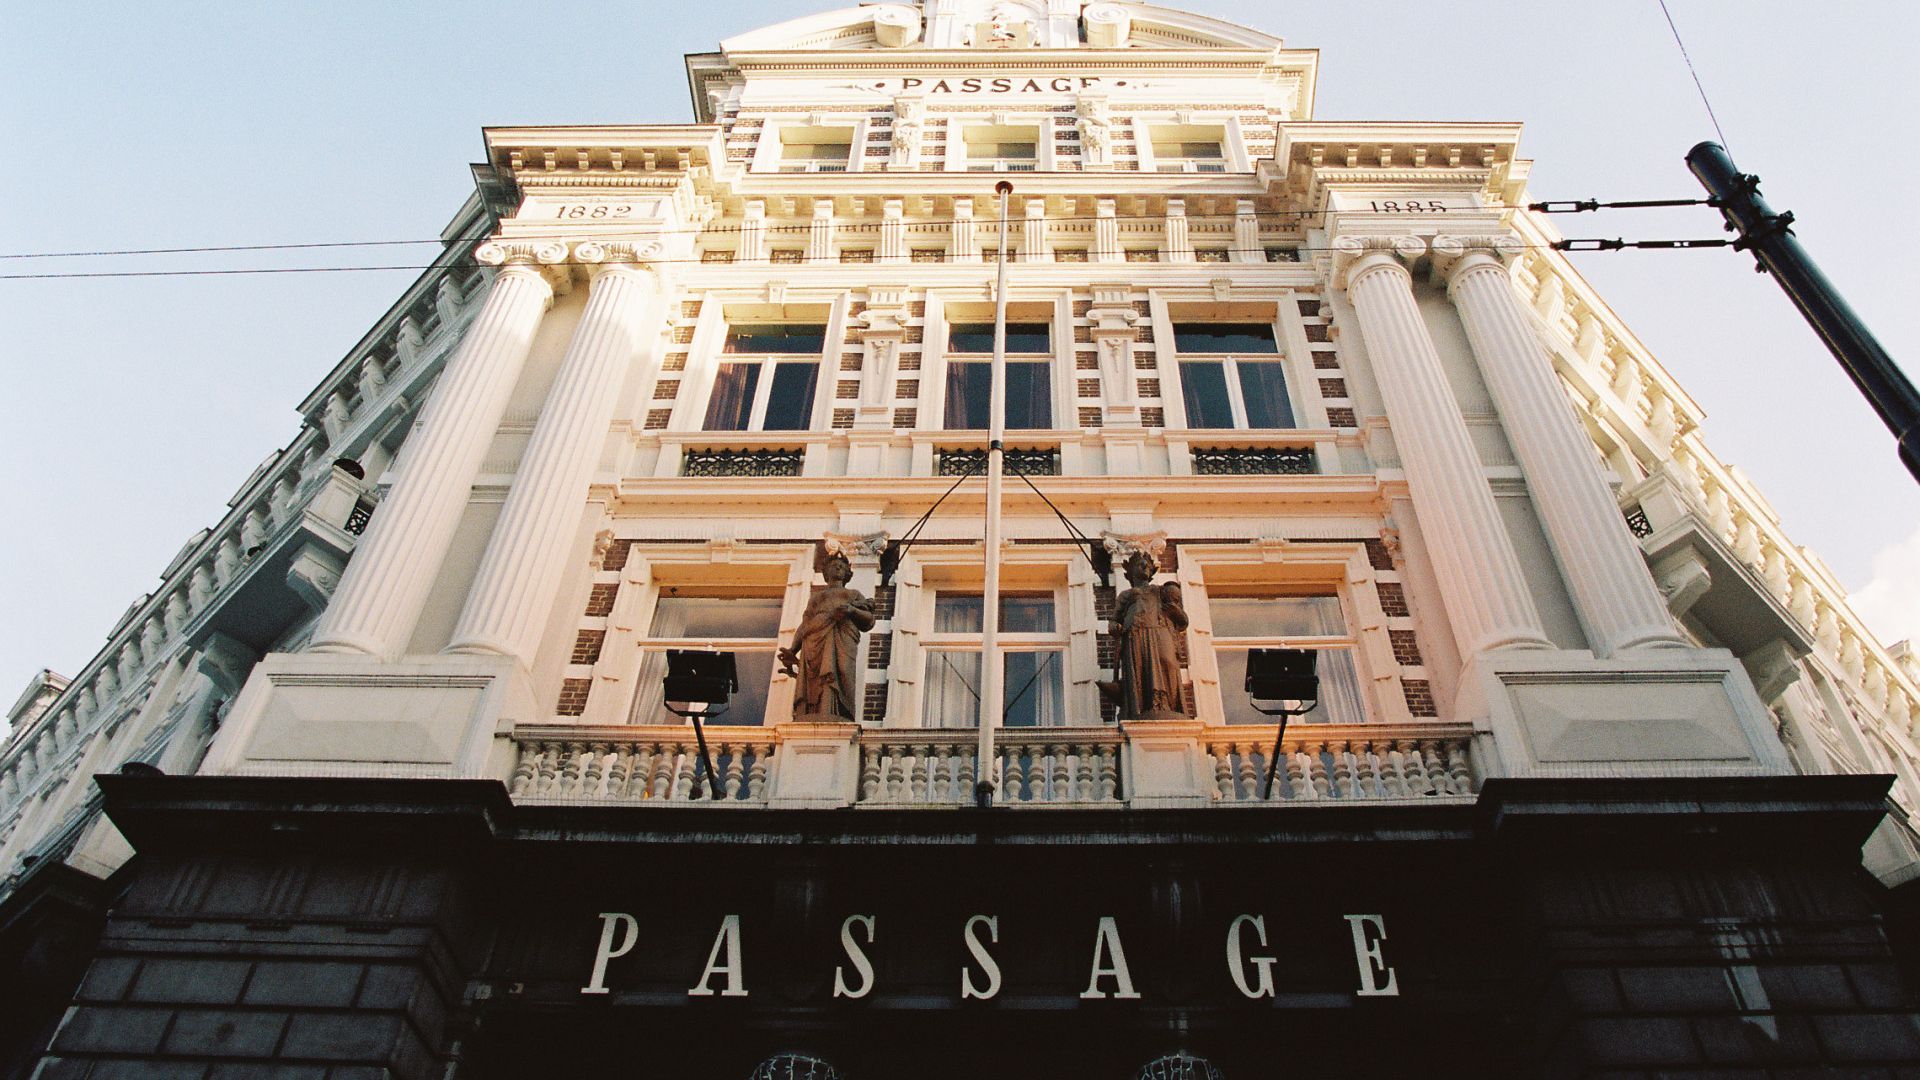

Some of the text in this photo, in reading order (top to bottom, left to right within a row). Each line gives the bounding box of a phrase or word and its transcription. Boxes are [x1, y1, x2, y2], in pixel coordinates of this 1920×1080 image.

[556, 205, 632, 219] 1882
[1369, 200, 1447, 213] 1885
[580, 912, 1400, 999] PASSAGE
